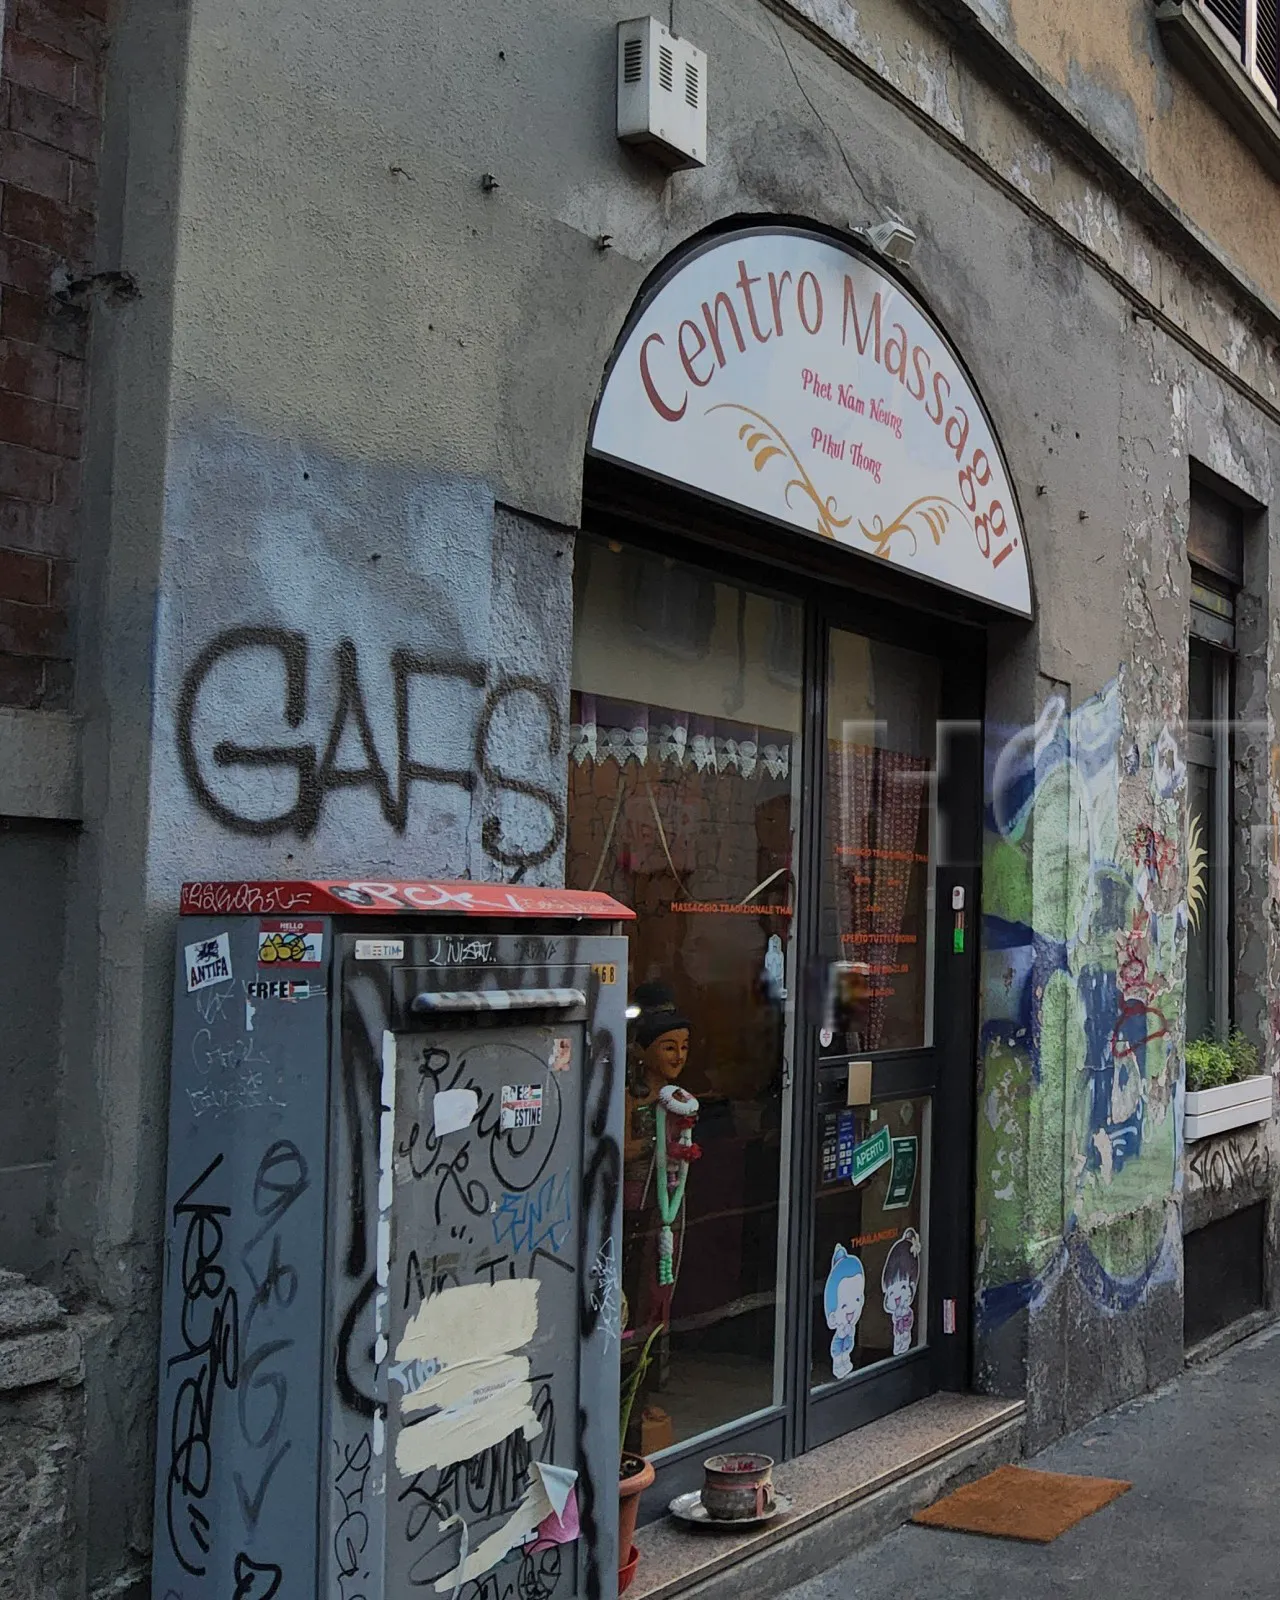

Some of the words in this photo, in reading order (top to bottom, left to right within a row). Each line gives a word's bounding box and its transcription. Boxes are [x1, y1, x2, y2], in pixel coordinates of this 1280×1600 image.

[639, 260, 823, 422] Centro
[842, 274, 1018, 569] Massaggi
[801, 368, 832, 401] Phet
[838, 384, 865, 415] Nam
[869, 398, 903, 439] Neung
[850, 442, 882, 484] Thong
[670, 902, 718, 913] MASSAGGIO
[720, 904, 774, 914] TRADIZIONALE
[280, 922, 304, 930] HELLO
[383, 945, 400, 956] TIM
[190, 957, 229, 988] ANTIFA
[247, 980, 289, 999] FREE
[856, 1140, 885, 1168] APERTO
